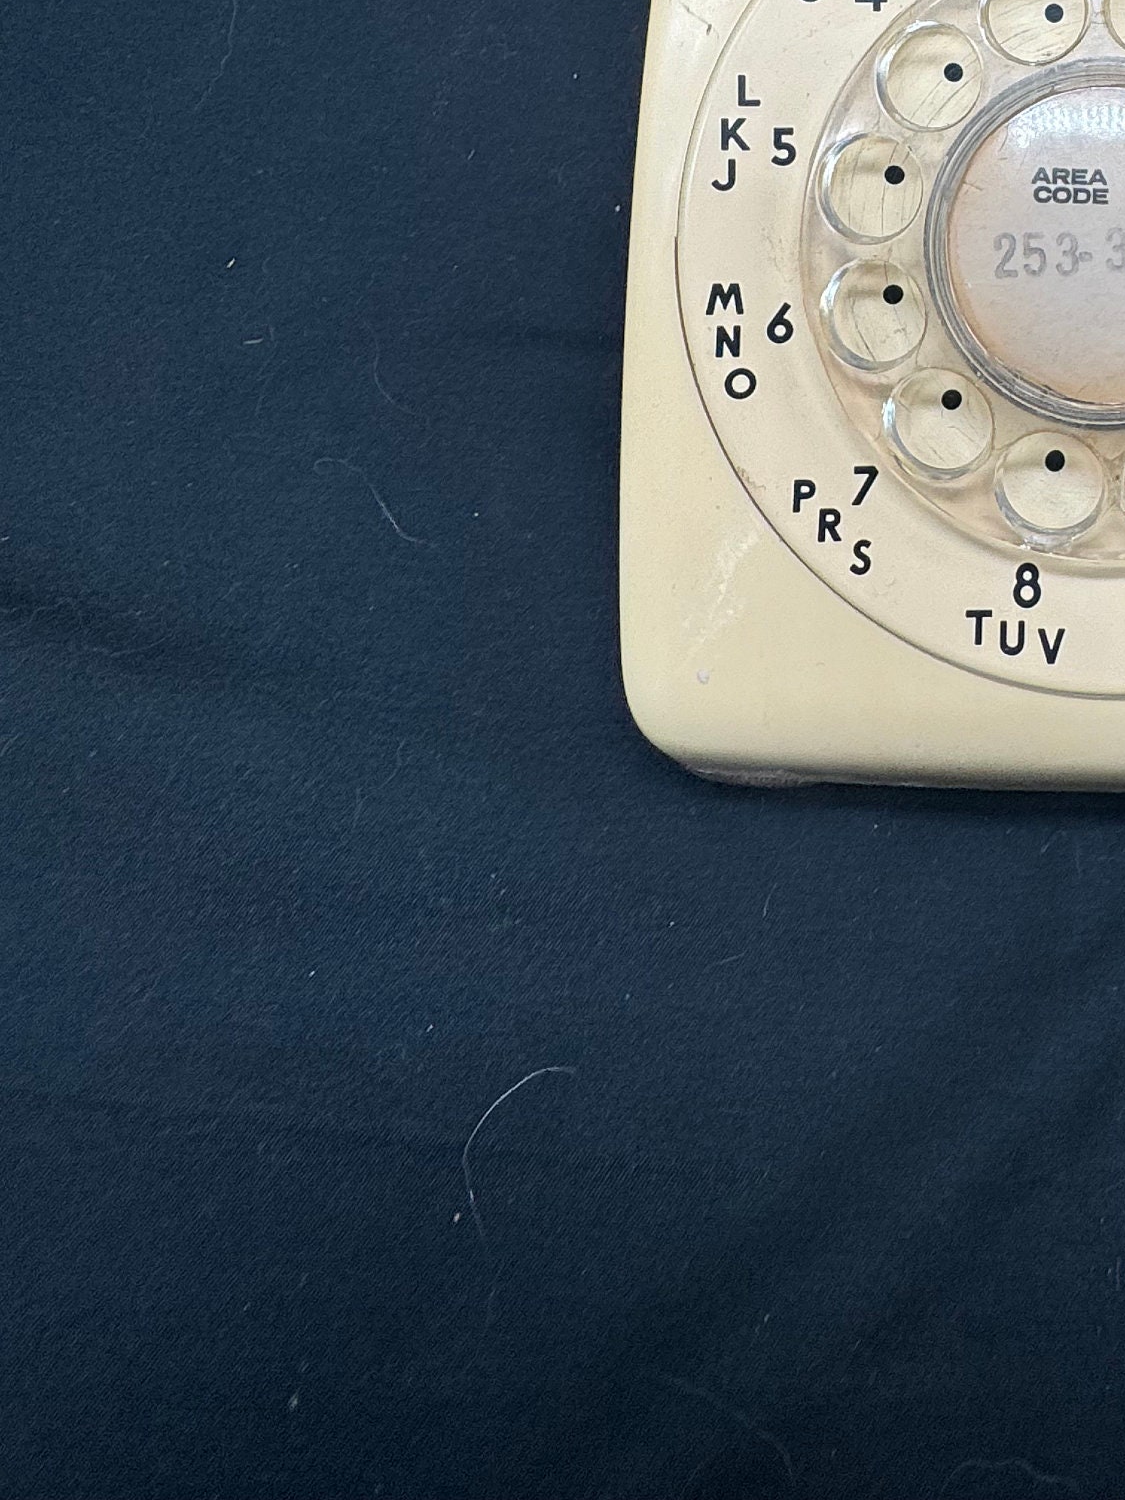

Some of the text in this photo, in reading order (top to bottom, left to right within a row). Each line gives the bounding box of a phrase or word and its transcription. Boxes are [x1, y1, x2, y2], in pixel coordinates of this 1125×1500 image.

[771, 127, 796, 166] 5
[1031, 167, 1108, 185] AREA
[1033, 186, 1109, 205] CODE
[766, 302, 794, 344] 6
[851, 466, 879, 506] 7
[1013, 562, 1042, 609] 8
[965, 609, 1066, 665] TUV
